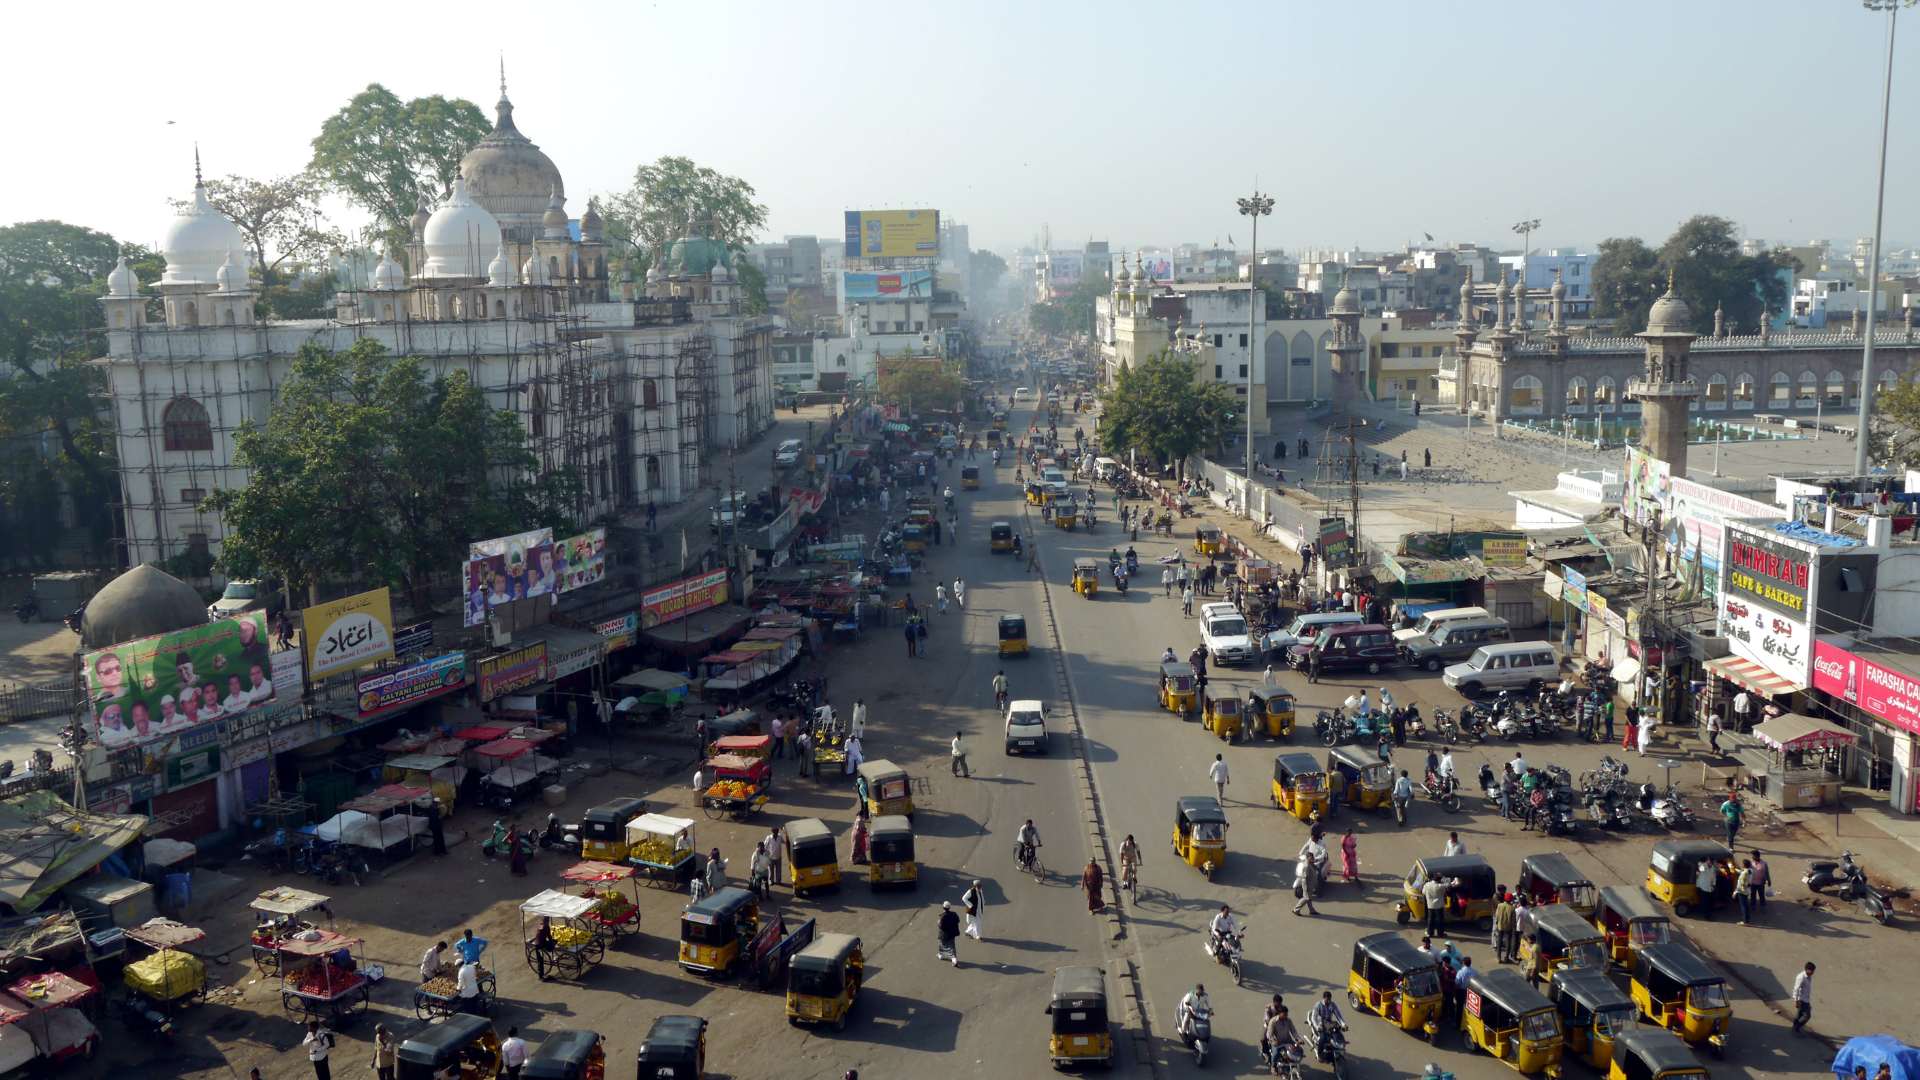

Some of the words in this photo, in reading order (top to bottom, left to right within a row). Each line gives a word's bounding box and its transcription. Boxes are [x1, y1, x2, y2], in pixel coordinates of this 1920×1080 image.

[1731, 540, 1808, 590] NIMRAH
[1732, 571, 1754, 591] CAFE
[1756, 582, 1763, 594] &
[1765, 585, 1804, 611] BAKERY
[326, 619, 373, 654] اعتماد
[380, 687, 413, 702] KALYANI
[414, 678, 443, 693] BIRYANI
[1866, 665, 1905, 695] FARASHA
[1906, 682, 1920, 701] CA
